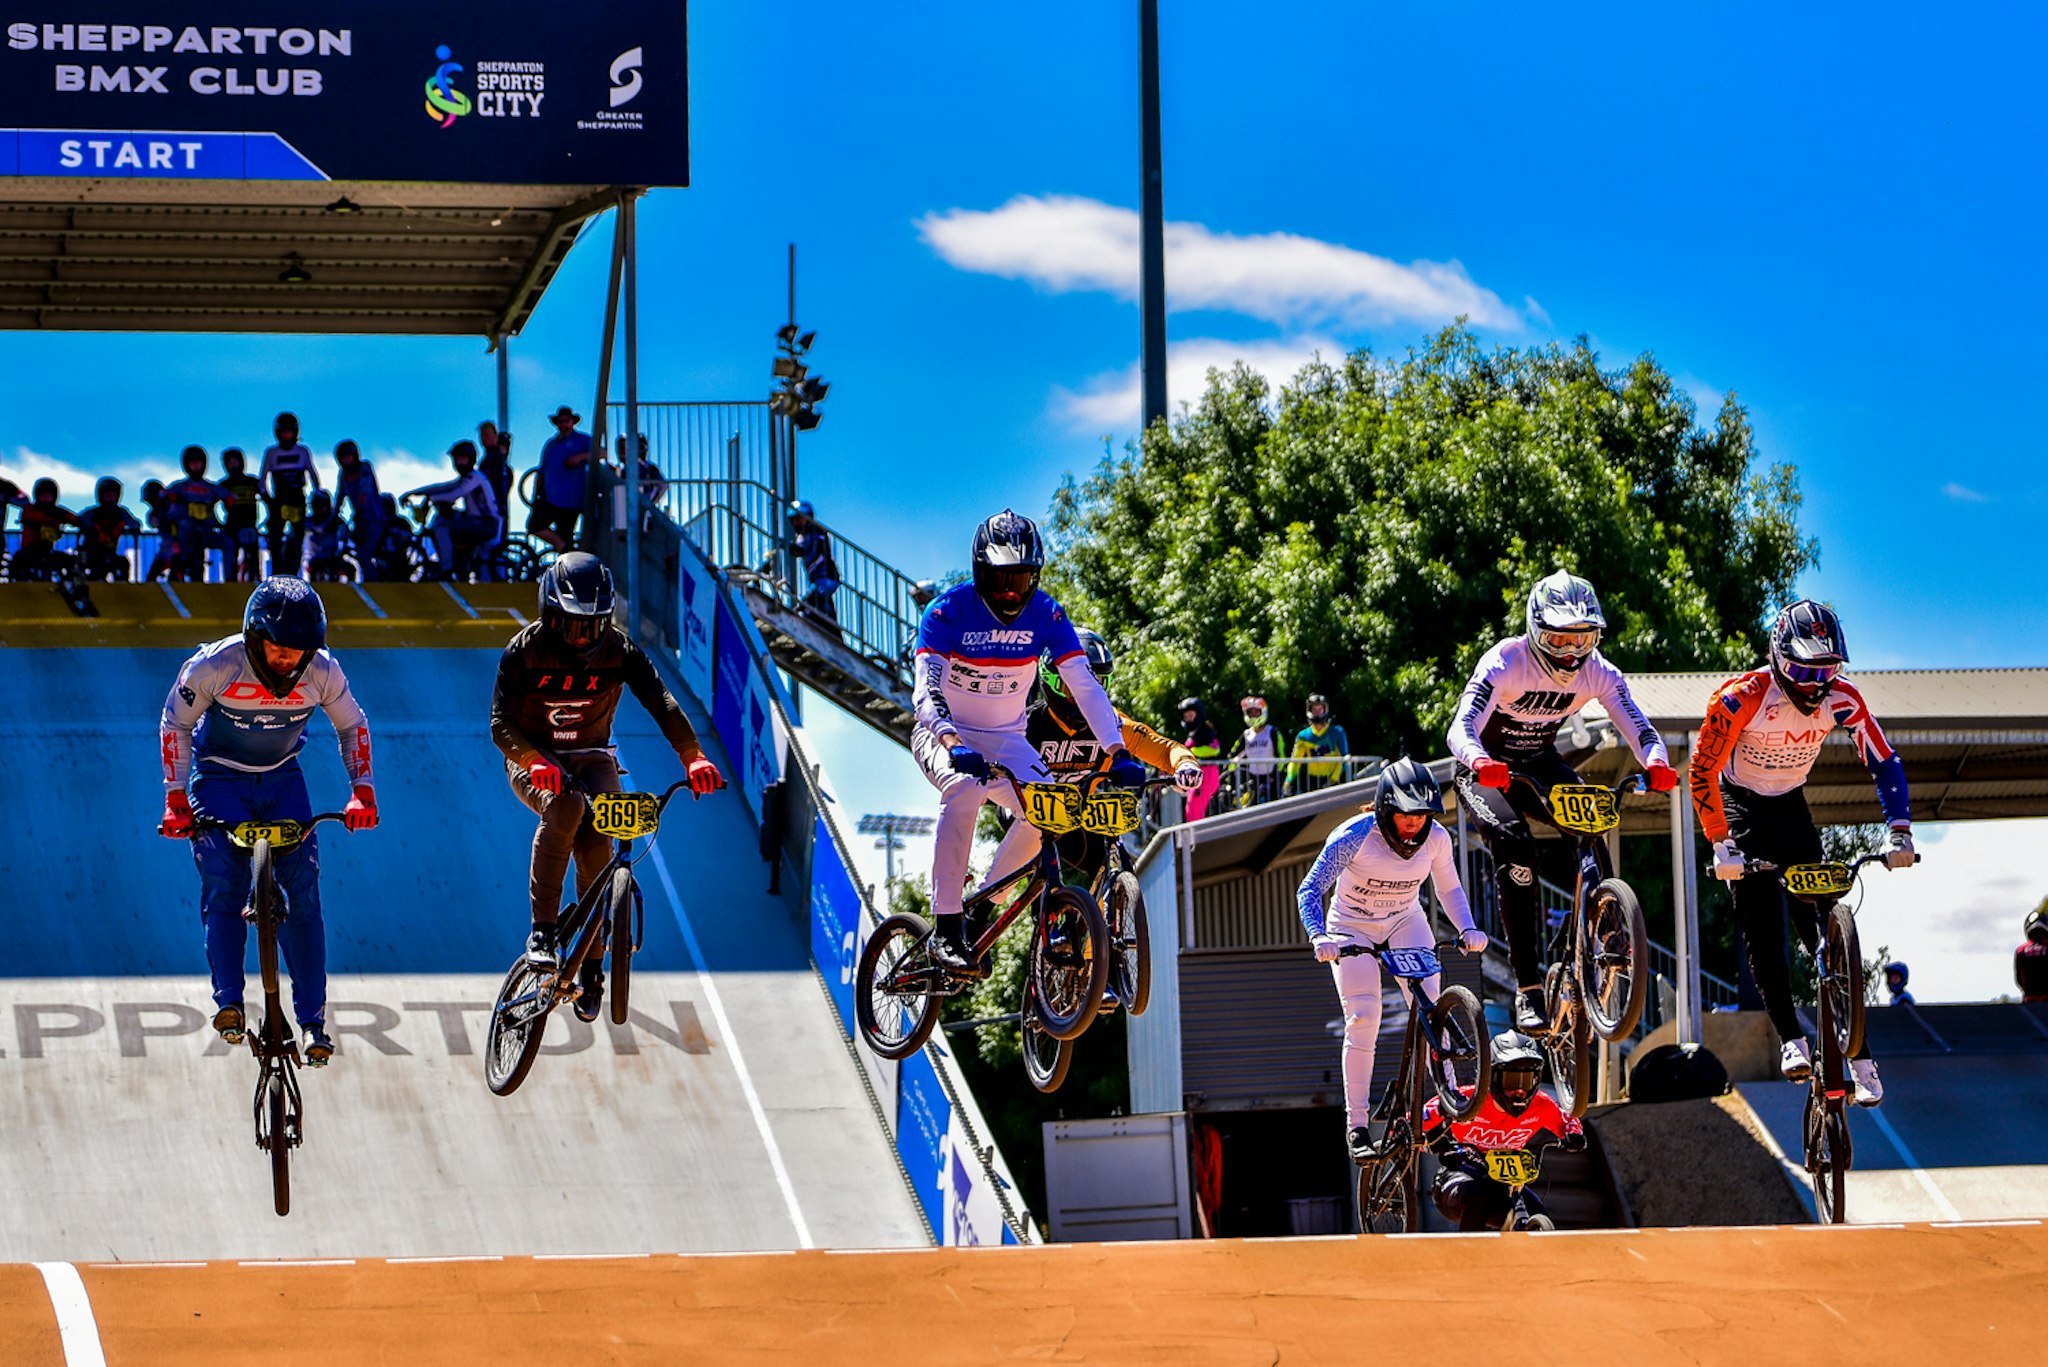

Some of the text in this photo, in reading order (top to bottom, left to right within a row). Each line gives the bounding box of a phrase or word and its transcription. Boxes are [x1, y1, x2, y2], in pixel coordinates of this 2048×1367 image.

[7, 22, 352, 56] SHEPPARTON
[55, 64, 323, 96] BMX CLUB
[477, 61, 544, 73] SHEPPARTON
[477, 74, 544, 90] SPORTS
[477, 91, 544, 117] CITY
[59, 140, 203, 170] START
[538, 675, 599, 690] FOX
[597, 802, 635, 829] 369
[1033, 794, 1056, 822] 97
[1085, 801, 1118, 828] 307
[1558, 796, 1596, 823] 198
[1791, 873, 1831, 890] 883
[1393, 954, 1422, 973] 66
[1495, 1158, 1518, 1178] 26
